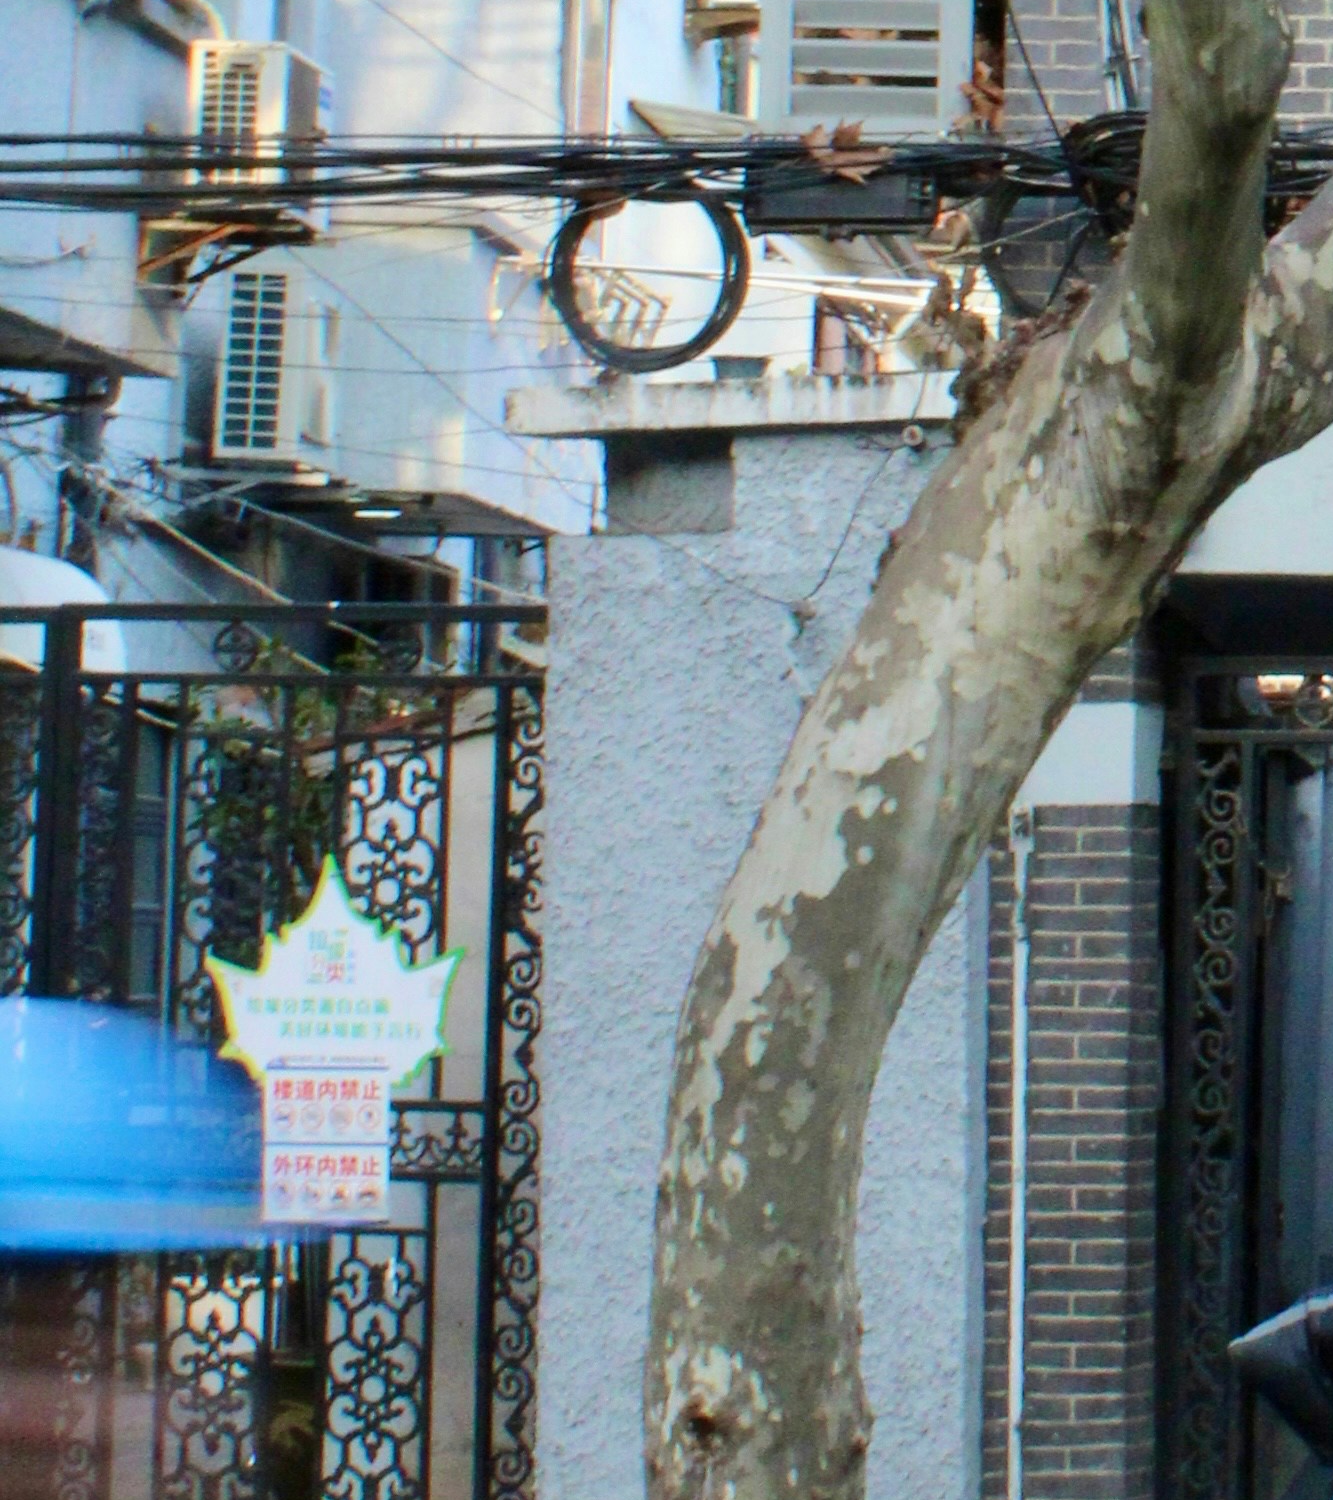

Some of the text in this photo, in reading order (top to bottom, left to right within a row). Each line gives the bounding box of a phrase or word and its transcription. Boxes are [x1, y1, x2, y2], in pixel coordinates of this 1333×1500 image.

[274, 1079, 381, 1100] 楼道内禁止
